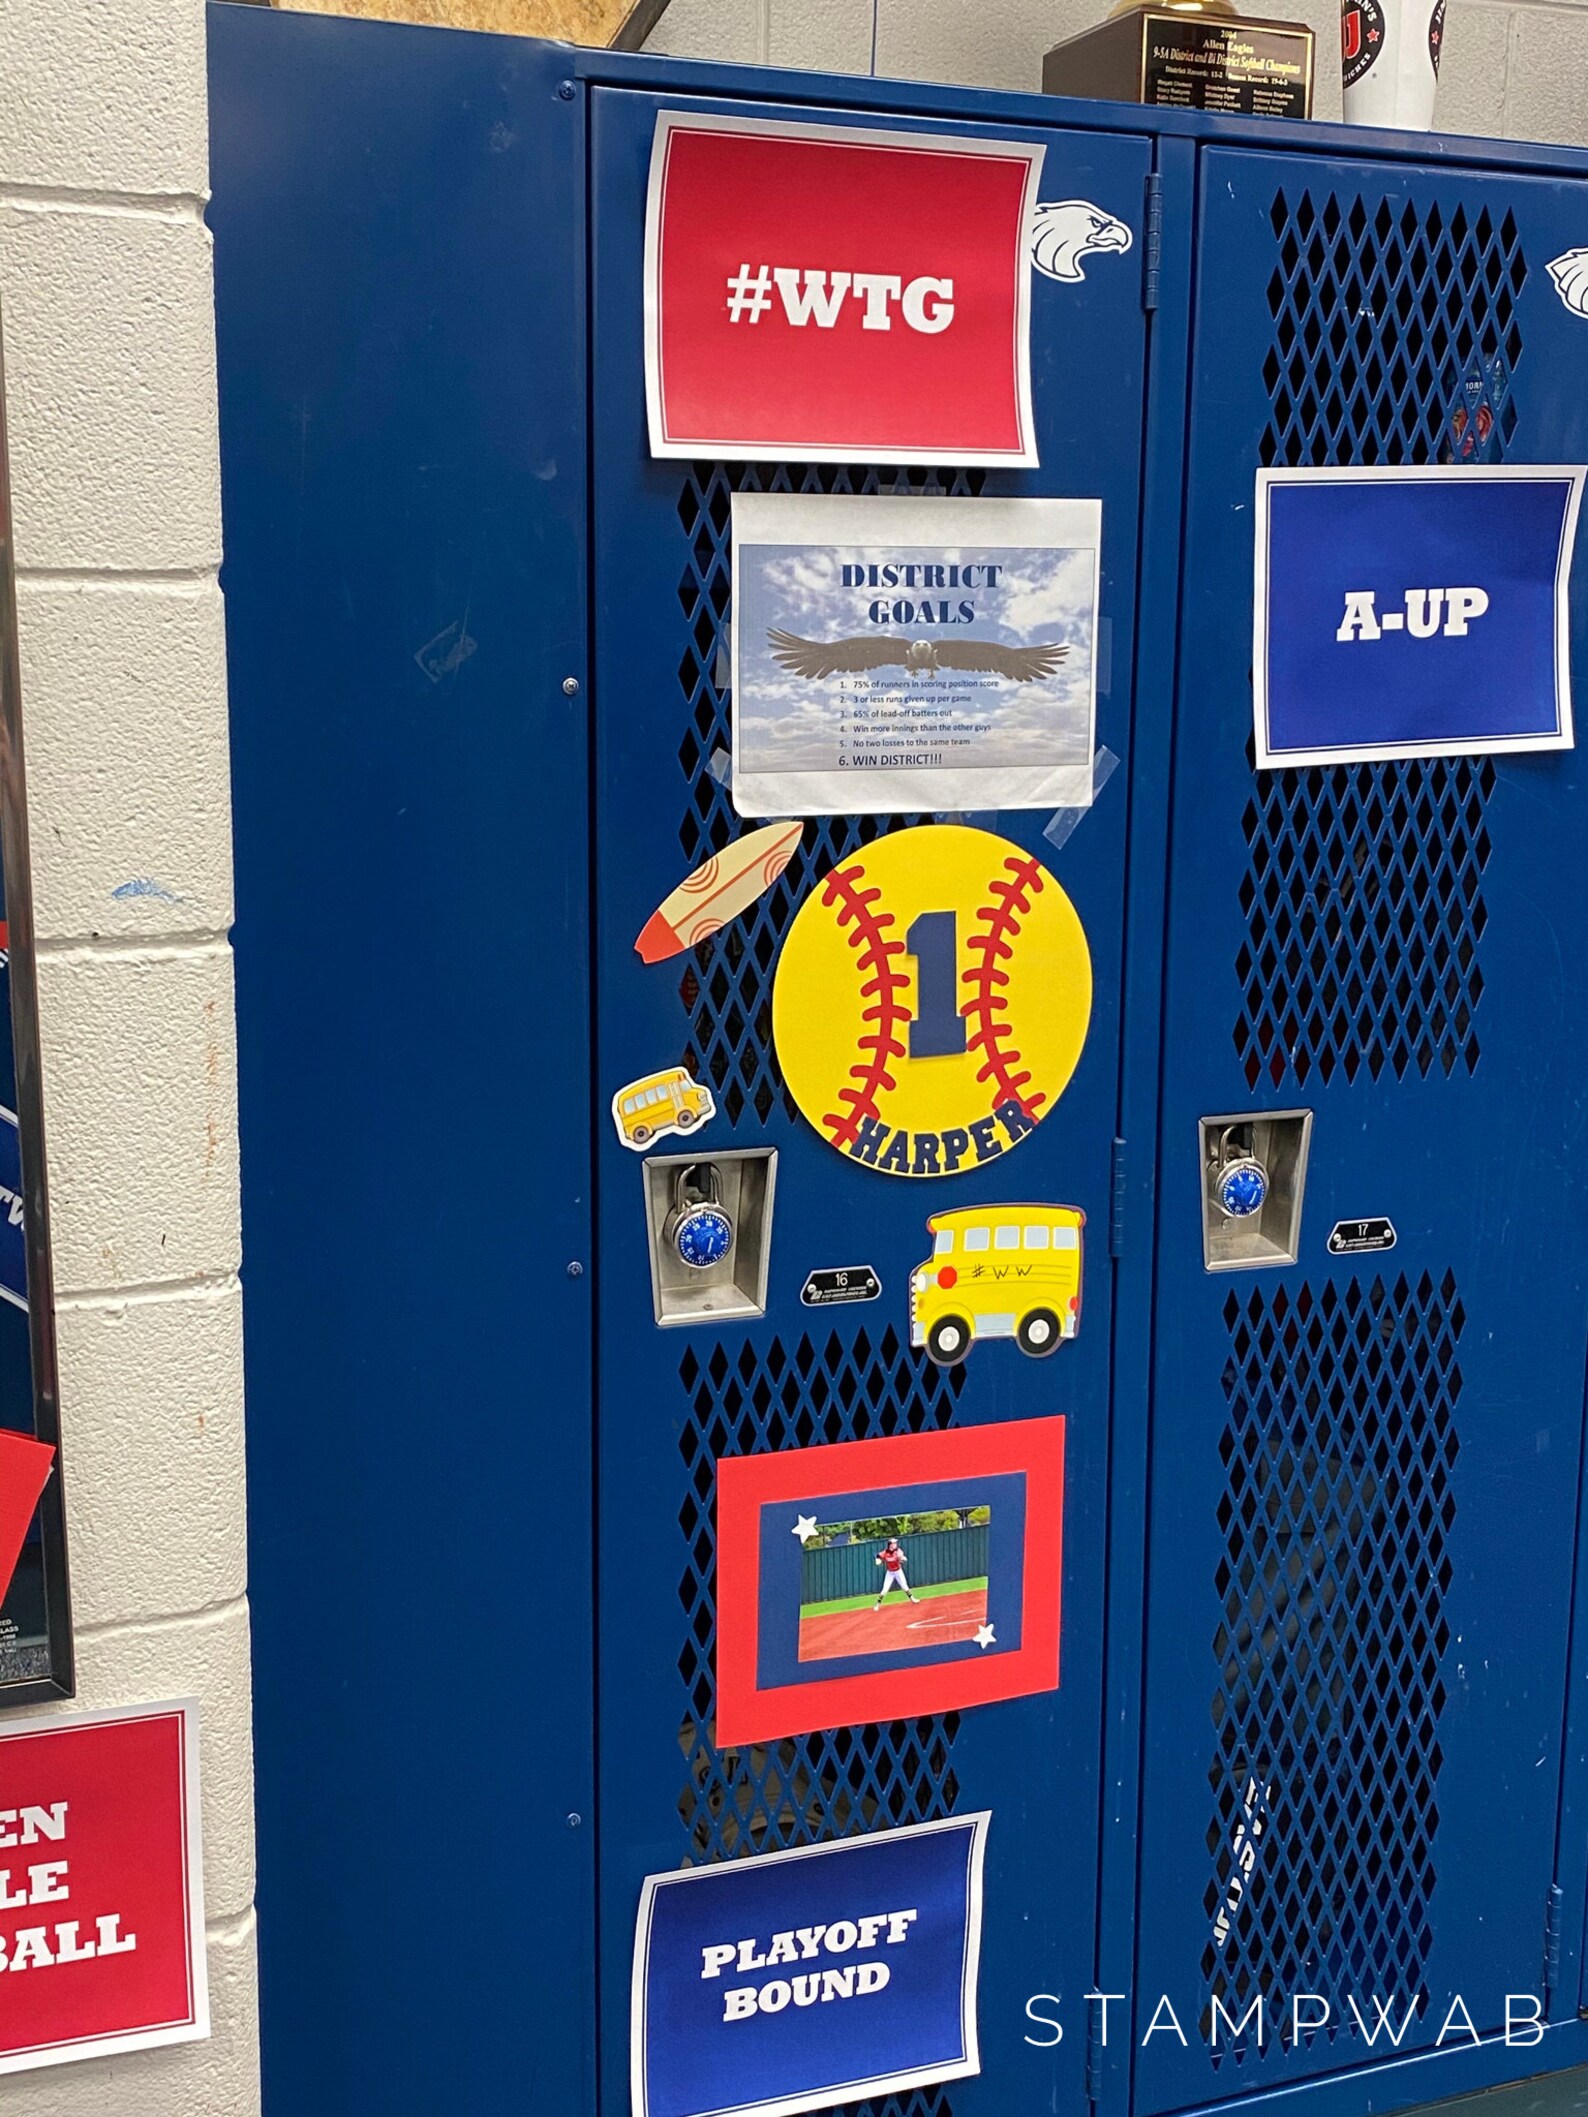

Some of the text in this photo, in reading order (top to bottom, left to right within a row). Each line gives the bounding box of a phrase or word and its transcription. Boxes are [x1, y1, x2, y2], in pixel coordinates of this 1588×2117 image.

[1203, 39, 1254, 54] Allen Eagles
[1170, 48, 1194, 62] District
[1195, 53, 1206, 63] and
[1217, 53, 1240, 67] District
[1241, 56, 1265, 71] Softball
[1266, 58, 1301, 75] Champions
[726, 263, 955, 334] #WTG
[840, 563, 1003, 589] DISTRICT
[868, 600, 975, 625] GOALS
[1336, 586, 1490, 642] A-UP
[853, 681, 870, 689] 75%
[871, 681, 880, 689] of
[881, 681, 910, 689] runners
[911, 681, 919, 689] in
[920, 680, 947, 690] scoring
[948, 680, 978, 690] position
[853, 696, 859, 704] 3
[869, 696, 885, 704] less
[885, 696, 902, 704] runs
[904, 695, 925, 705] given
[925, 696, 936, 705] up
[937, 696, 950, 705] per
[951, 695, 972, 704] game
[853, 710, 870, 719] 65%
[871, 710, 880, 718] of
[881, 710, 911, 718] lead-off
[911, 709, 938, 718] batters
[939, 709, 952, 717] out
[853, 725, 869, 733] Win
[891, 725, 919, 734] innings
[920, 724, 938, 732] than
[974, 724, 991, 733] guys
[853, 740, 864, 748] No
[865, 740, 880, 748] two
[882, 739, 905, 747] losses
[906, 739, 915, 747] to
[916, 739, 928, 747] the
[929, 739, 950, 747] same
[951, 738, 971, 746] team
[838, 752, 942, 767] 6. WIN DISTRICT!!!
[906, 911, 967, 1058] 1
[851, 1098, 1033, 1175] HARPER
[1358, 1223, 1369, 1237] 17
[835, 1272, 848, 1287] 16
[0, 1860, 69, 1910] LE
[0, 1913, 136, 1973] ALL
[701, 1908, 918, 1979] PLAYOFF
[723, 1961, 891, 2023] BOUND
